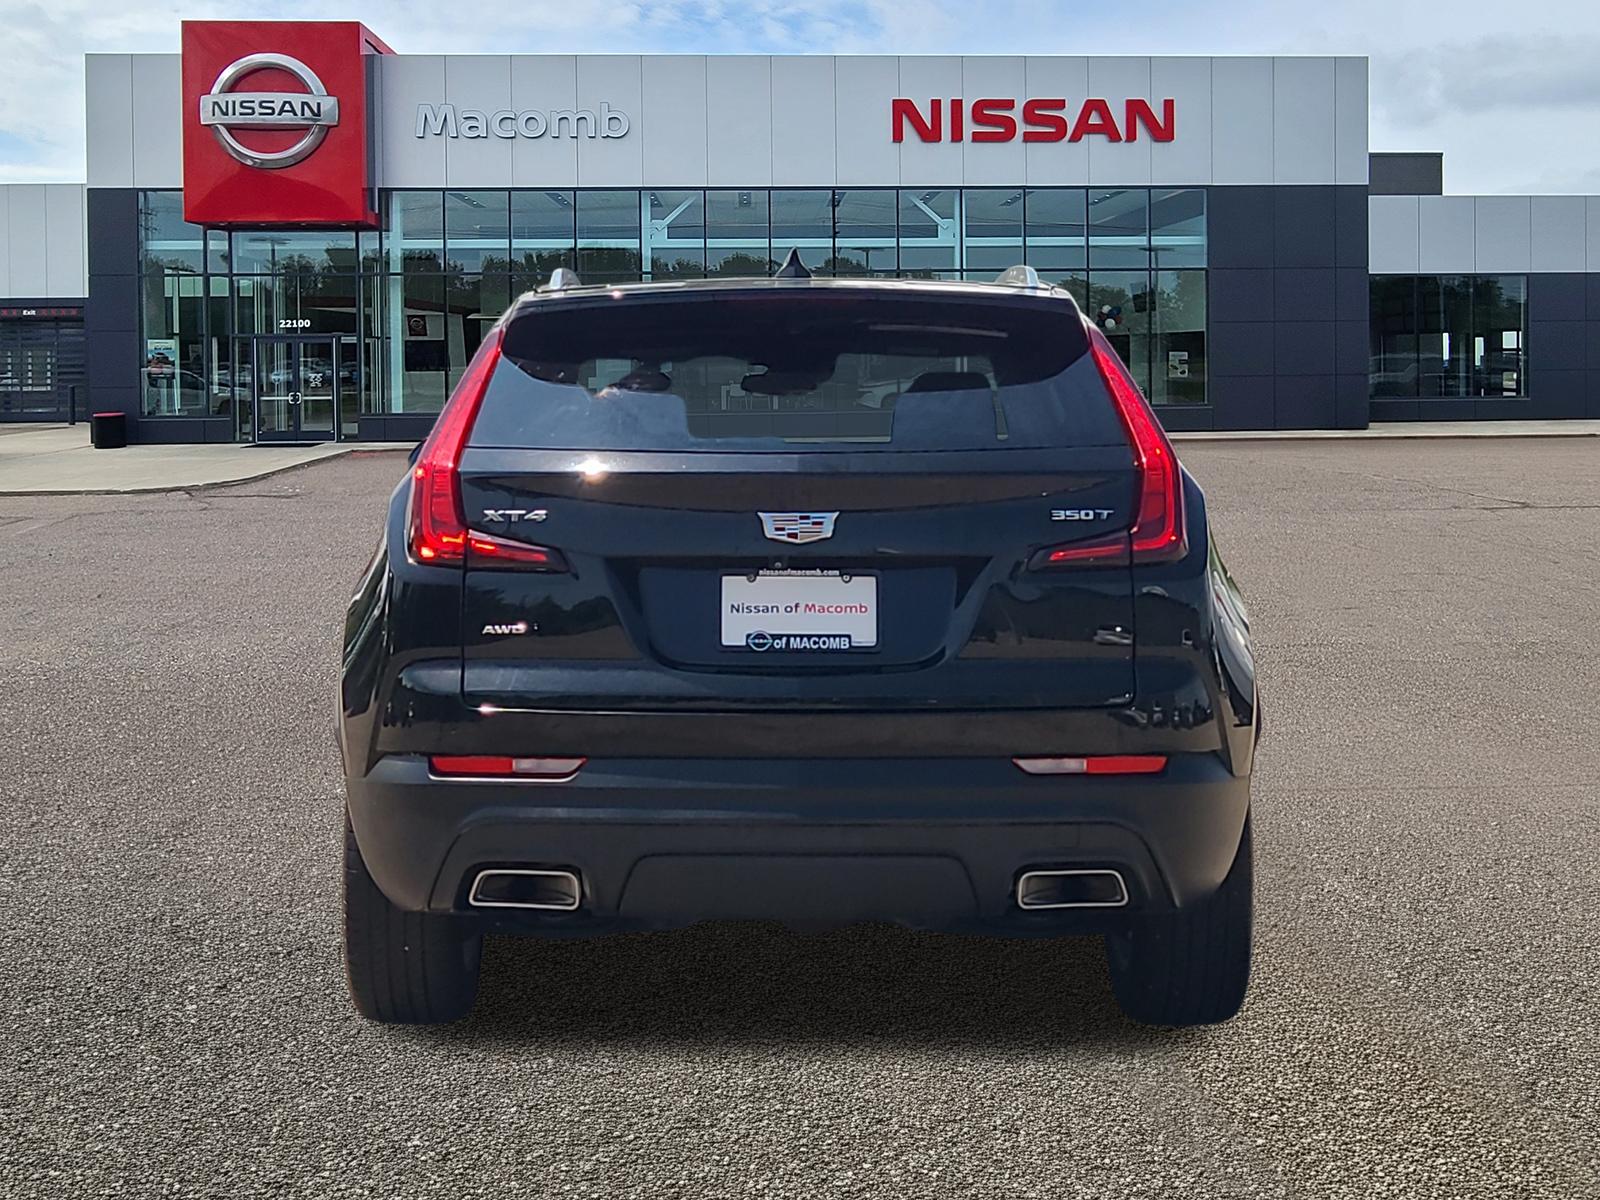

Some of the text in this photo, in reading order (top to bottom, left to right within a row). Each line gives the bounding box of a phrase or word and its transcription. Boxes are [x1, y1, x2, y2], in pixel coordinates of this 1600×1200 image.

[212, 100, 321, 117] NISSAN
[415, 102, 630, 139] Macomb
[892, 98, 1175, 143] NISSAN
[279, 319, 311, 328] 22100
[483, 510, 548, 522] XT4
[1051, 509, 1114, 520] 350T
[730, 602, 868, 614] Nissan of Macomb
[481, 624, 527, 634] AWD
[773, 636, 850, 649] of MACOMB
